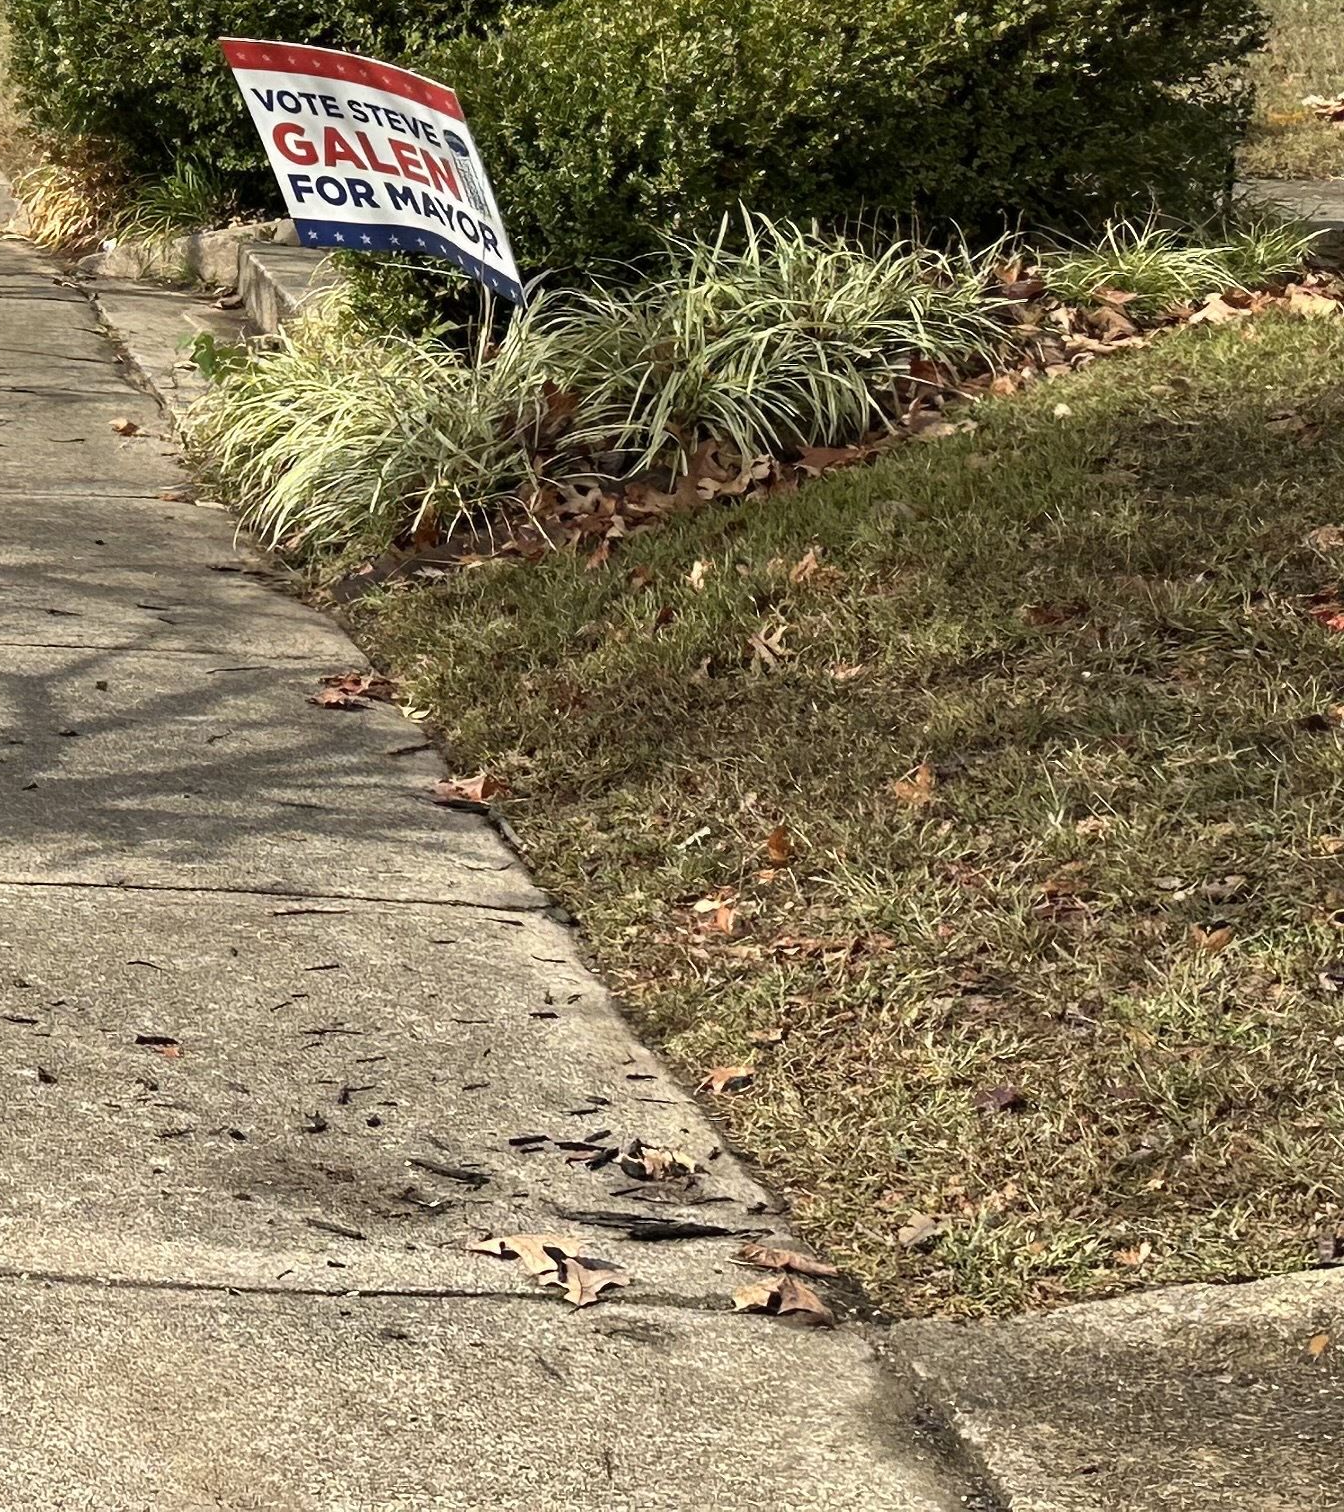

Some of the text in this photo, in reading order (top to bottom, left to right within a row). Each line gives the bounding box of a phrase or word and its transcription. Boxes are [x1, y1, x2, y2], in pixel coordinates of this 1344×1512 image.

[250, 88, 442, 148] VOTE STEVE
[272, 122, 464, 203] GALEN
[287, 173, 503, 260] FOR MAYOR
